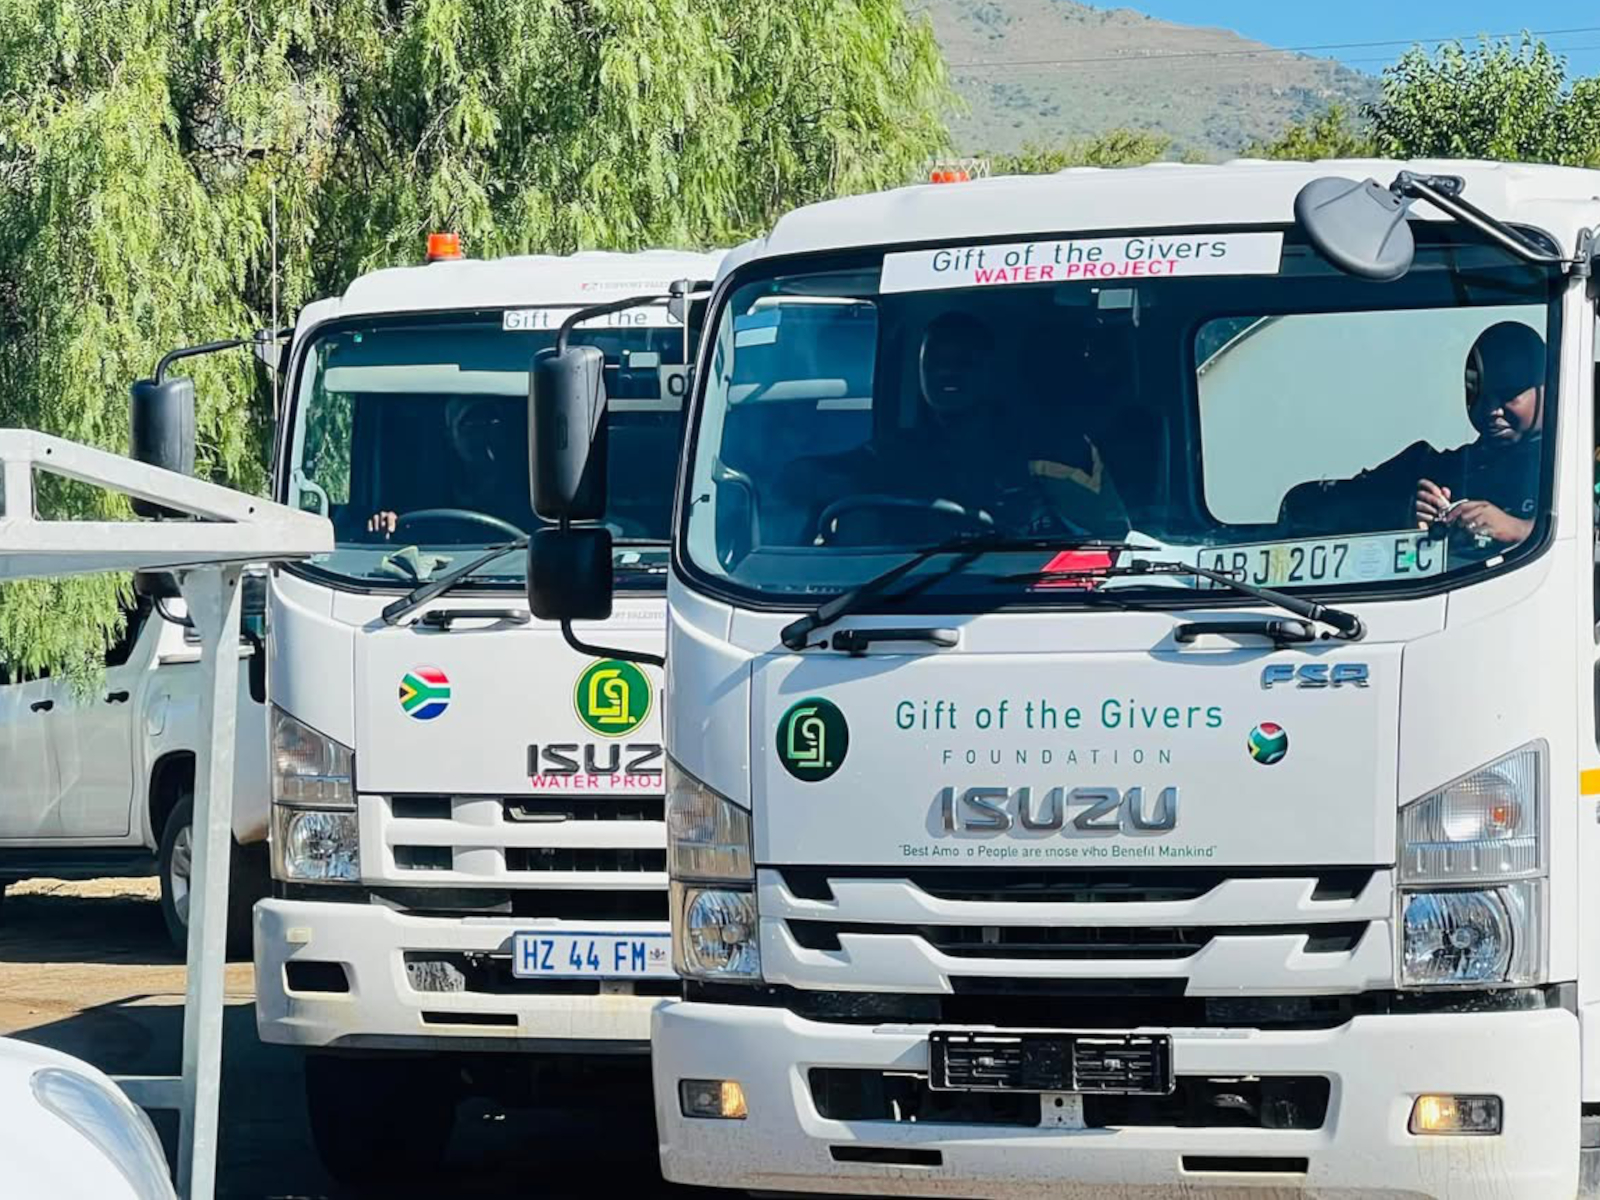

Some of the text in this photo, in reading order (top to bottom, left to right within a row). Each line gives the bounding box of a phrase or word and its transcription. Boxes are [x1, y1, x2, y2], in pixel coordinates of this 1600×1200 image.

[932, 237, 1228, 272] Gift of the Givers
[973, 258, 1181, 284] WATER PROJECT
[504, 310, 549, 329] Gift
[606, 309, 647, 326] the
[1211, 550, 1271, 588] ABJ
[1288, 543, 1349, 580] 207
[1394, 536, 1432, 573] EC
[1261, 663, 1370, 690] FSR
[896, 698, 1223, 730] Gift of the Givers
[527, 743, 664, 777] ISUZ
[943, 749, 1173, 765] FOUNDATION
[531, 775, 663, 789] WATER PROJ
[937, 785, 1179, 833] ISUZU
[978, 845, 1018, 859] People
[1022, 848, 1042, 857] are
[523, 940, 646, 971] HZ 44 FM
